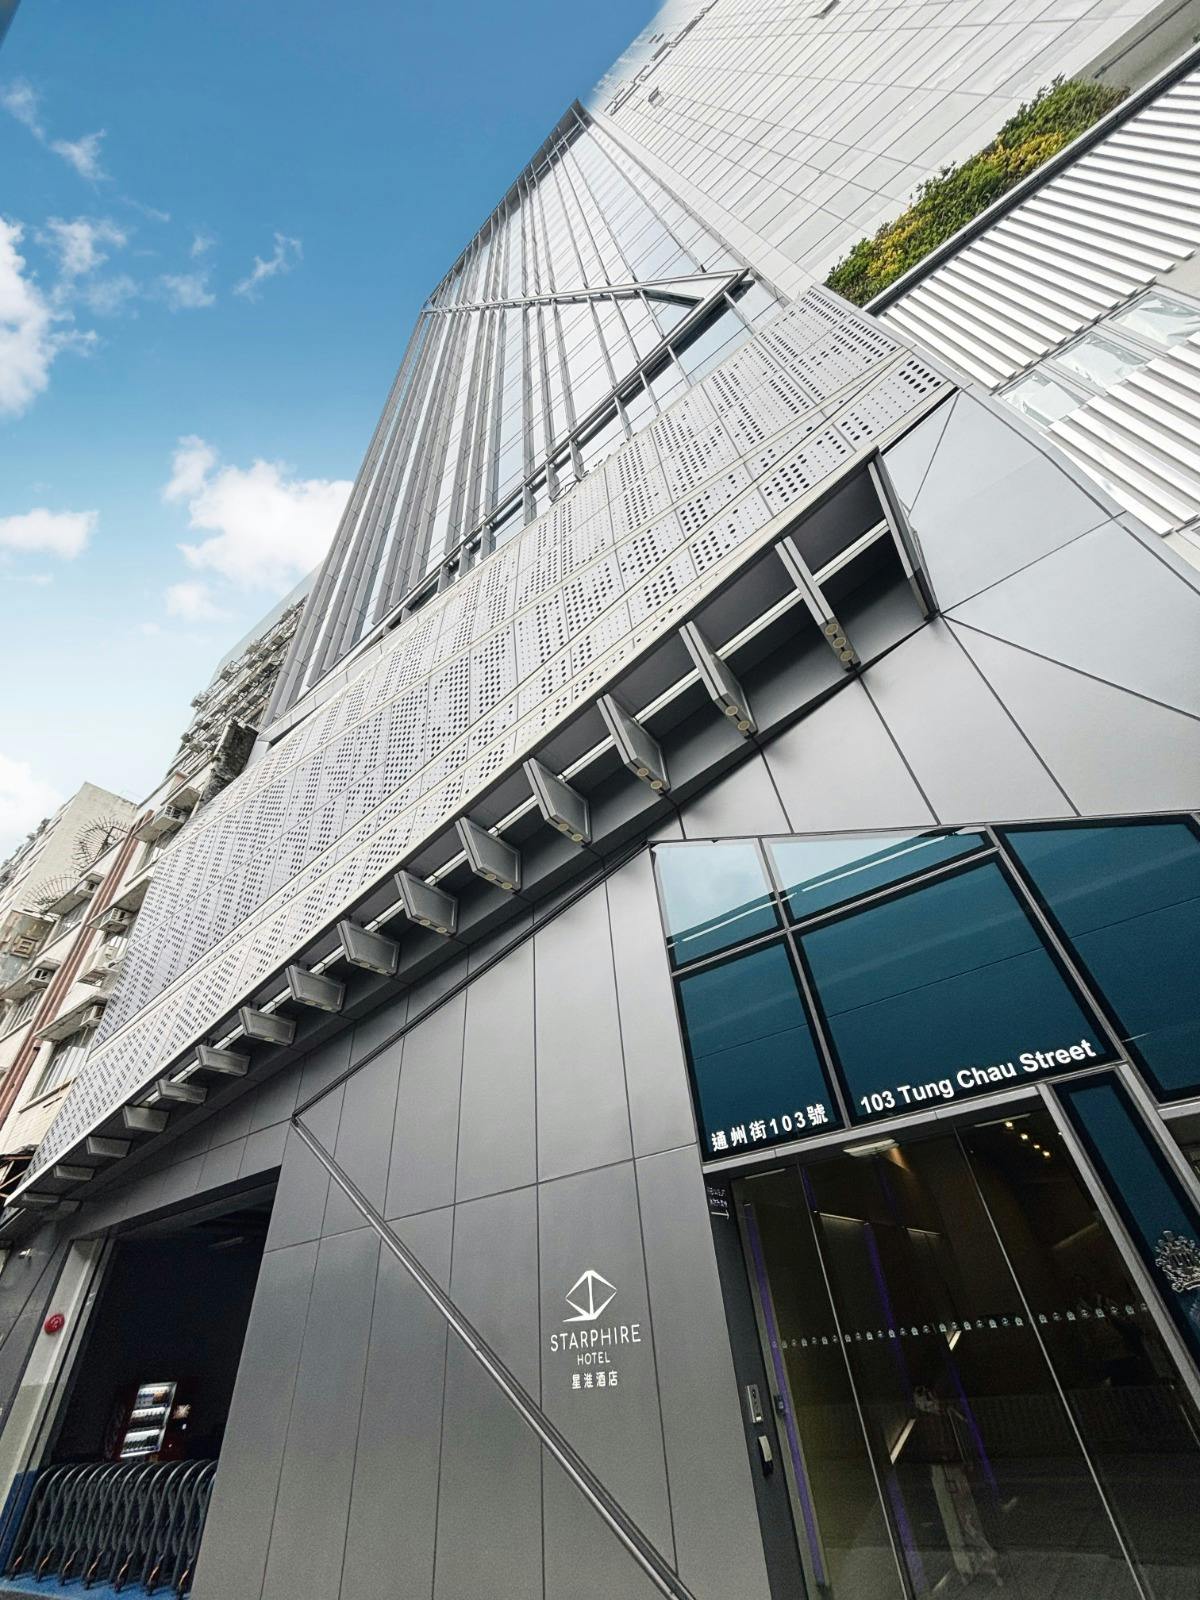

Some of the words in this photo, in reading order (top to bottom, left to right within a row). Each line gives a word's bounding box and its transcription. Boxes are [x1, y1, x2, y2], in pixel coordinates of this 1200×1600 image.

[860, 1090, 896, 1114] 103
[897, 1079, 955, 1099] Tung
[956, 1061, 1018, 1089] Chau
[1019, 1039, 1097, 1073] Street
[550, 1324, 641, 1351] STARPHIRE
[577, 1351, 611, 1366] HOTEL
